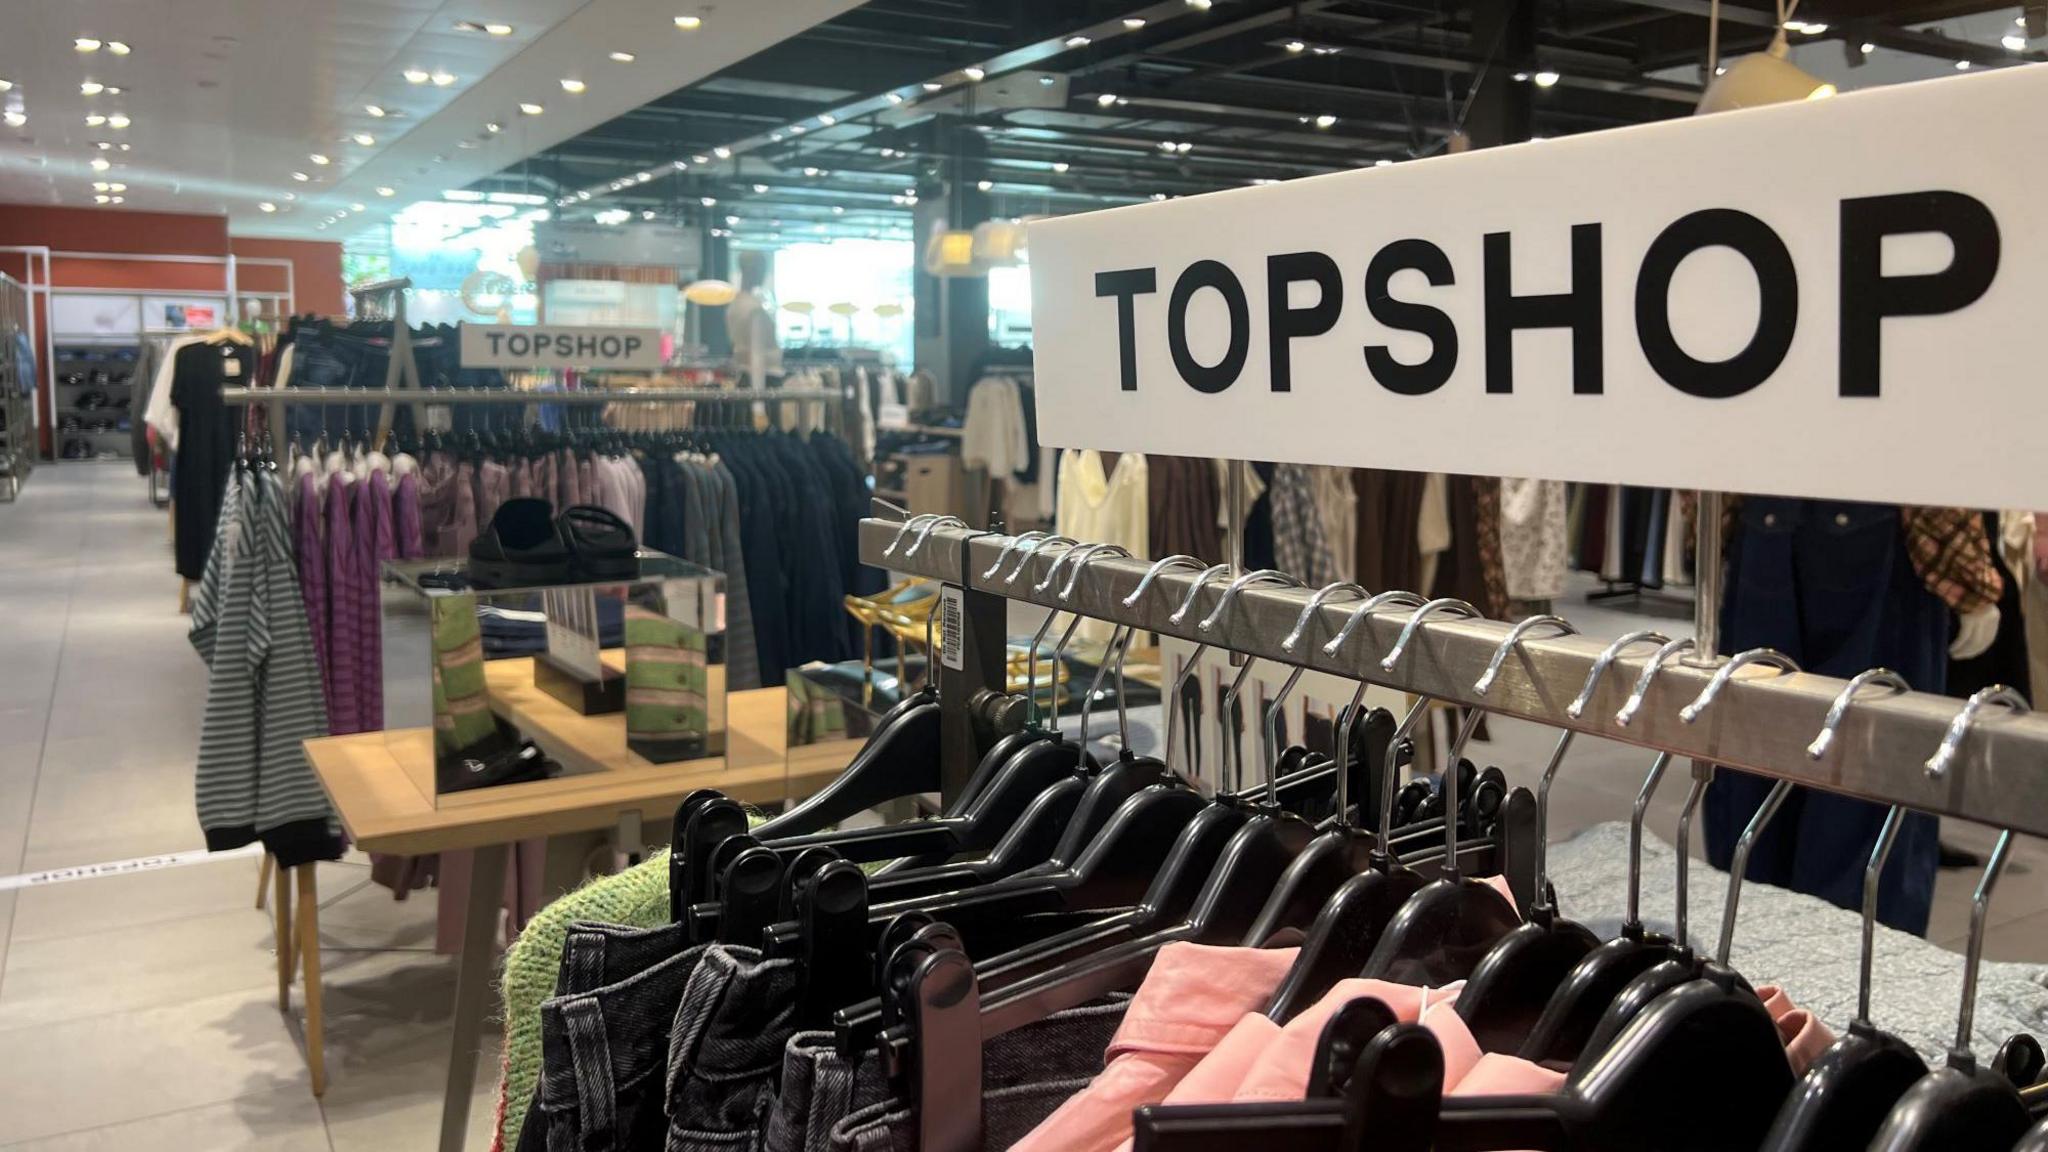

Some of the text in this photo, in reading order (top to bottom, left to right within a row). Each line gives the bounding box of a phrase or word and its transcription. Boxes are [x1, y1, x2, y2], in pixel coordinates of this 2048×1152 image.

[1095, 190, 2001, 399] TOPSHOP
[486, 331, 642, 359] TOPSHOP
[31, 856, 181, 883] TOPSHOP
